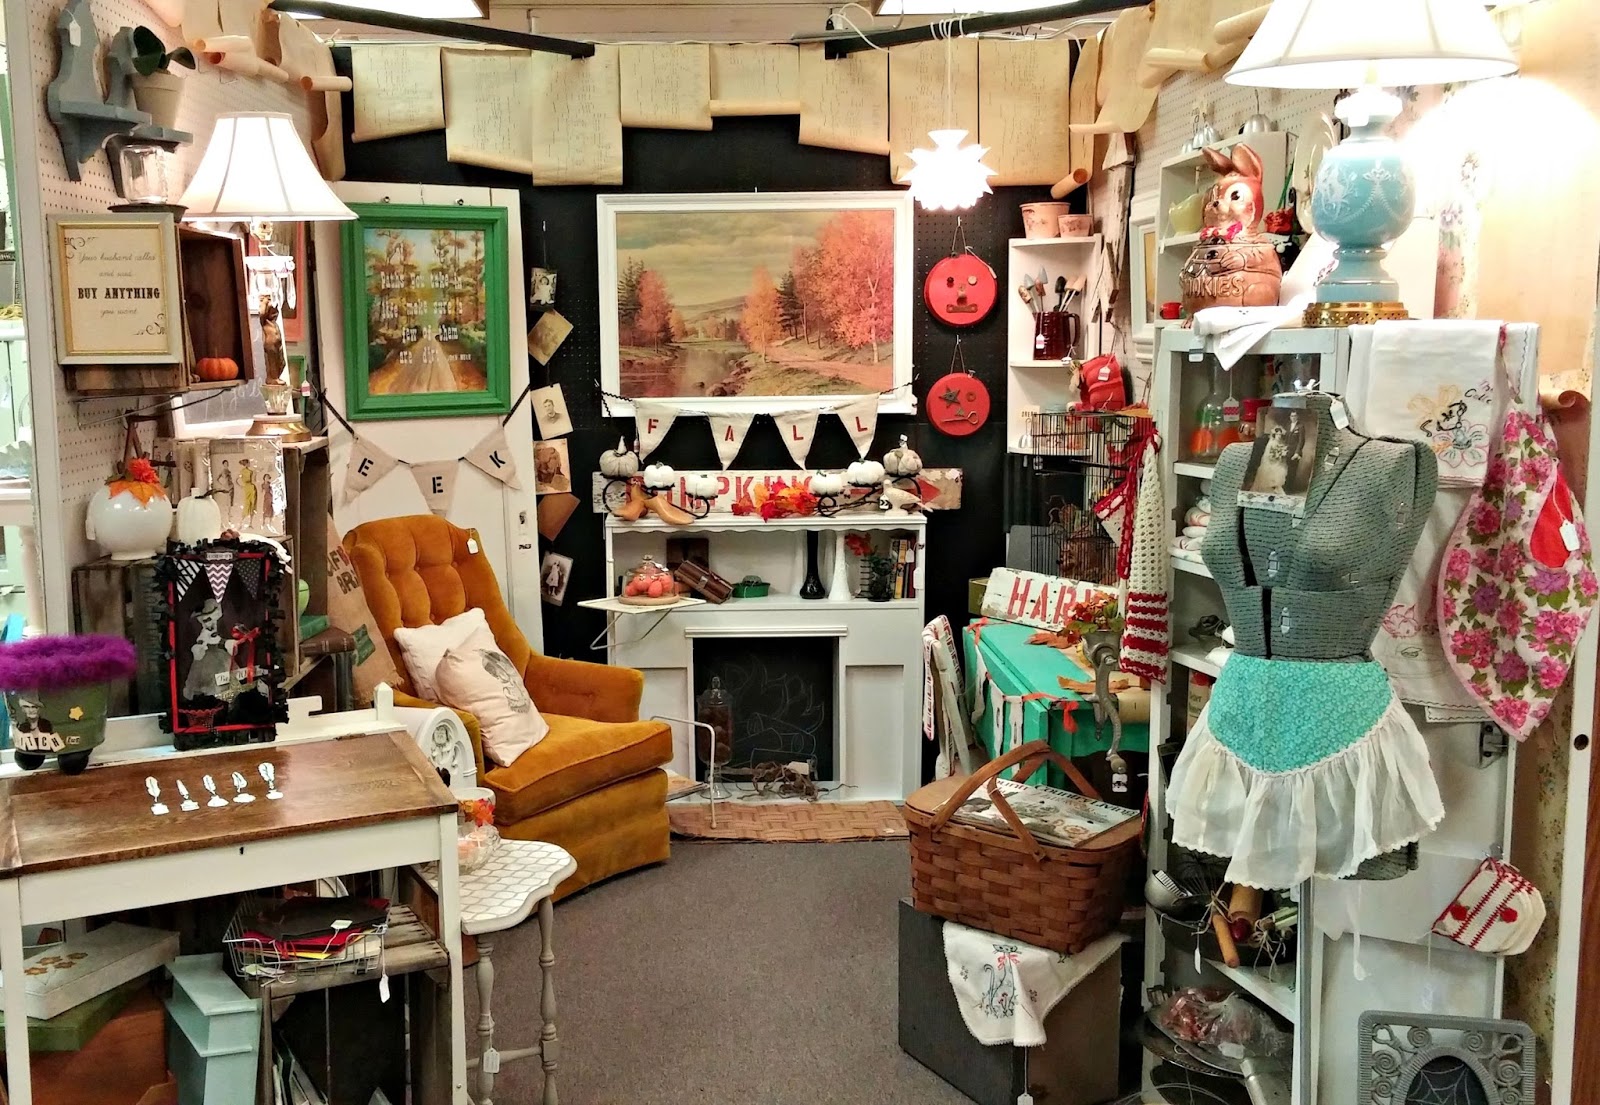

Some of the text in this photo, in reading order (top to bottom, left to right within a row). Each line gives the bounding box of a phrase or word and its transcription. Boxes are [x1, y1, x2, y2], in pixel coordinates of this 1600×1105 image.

[100, 252, 133, 261] husband
[78, 287, 160, 299] BUY ANYTHING
